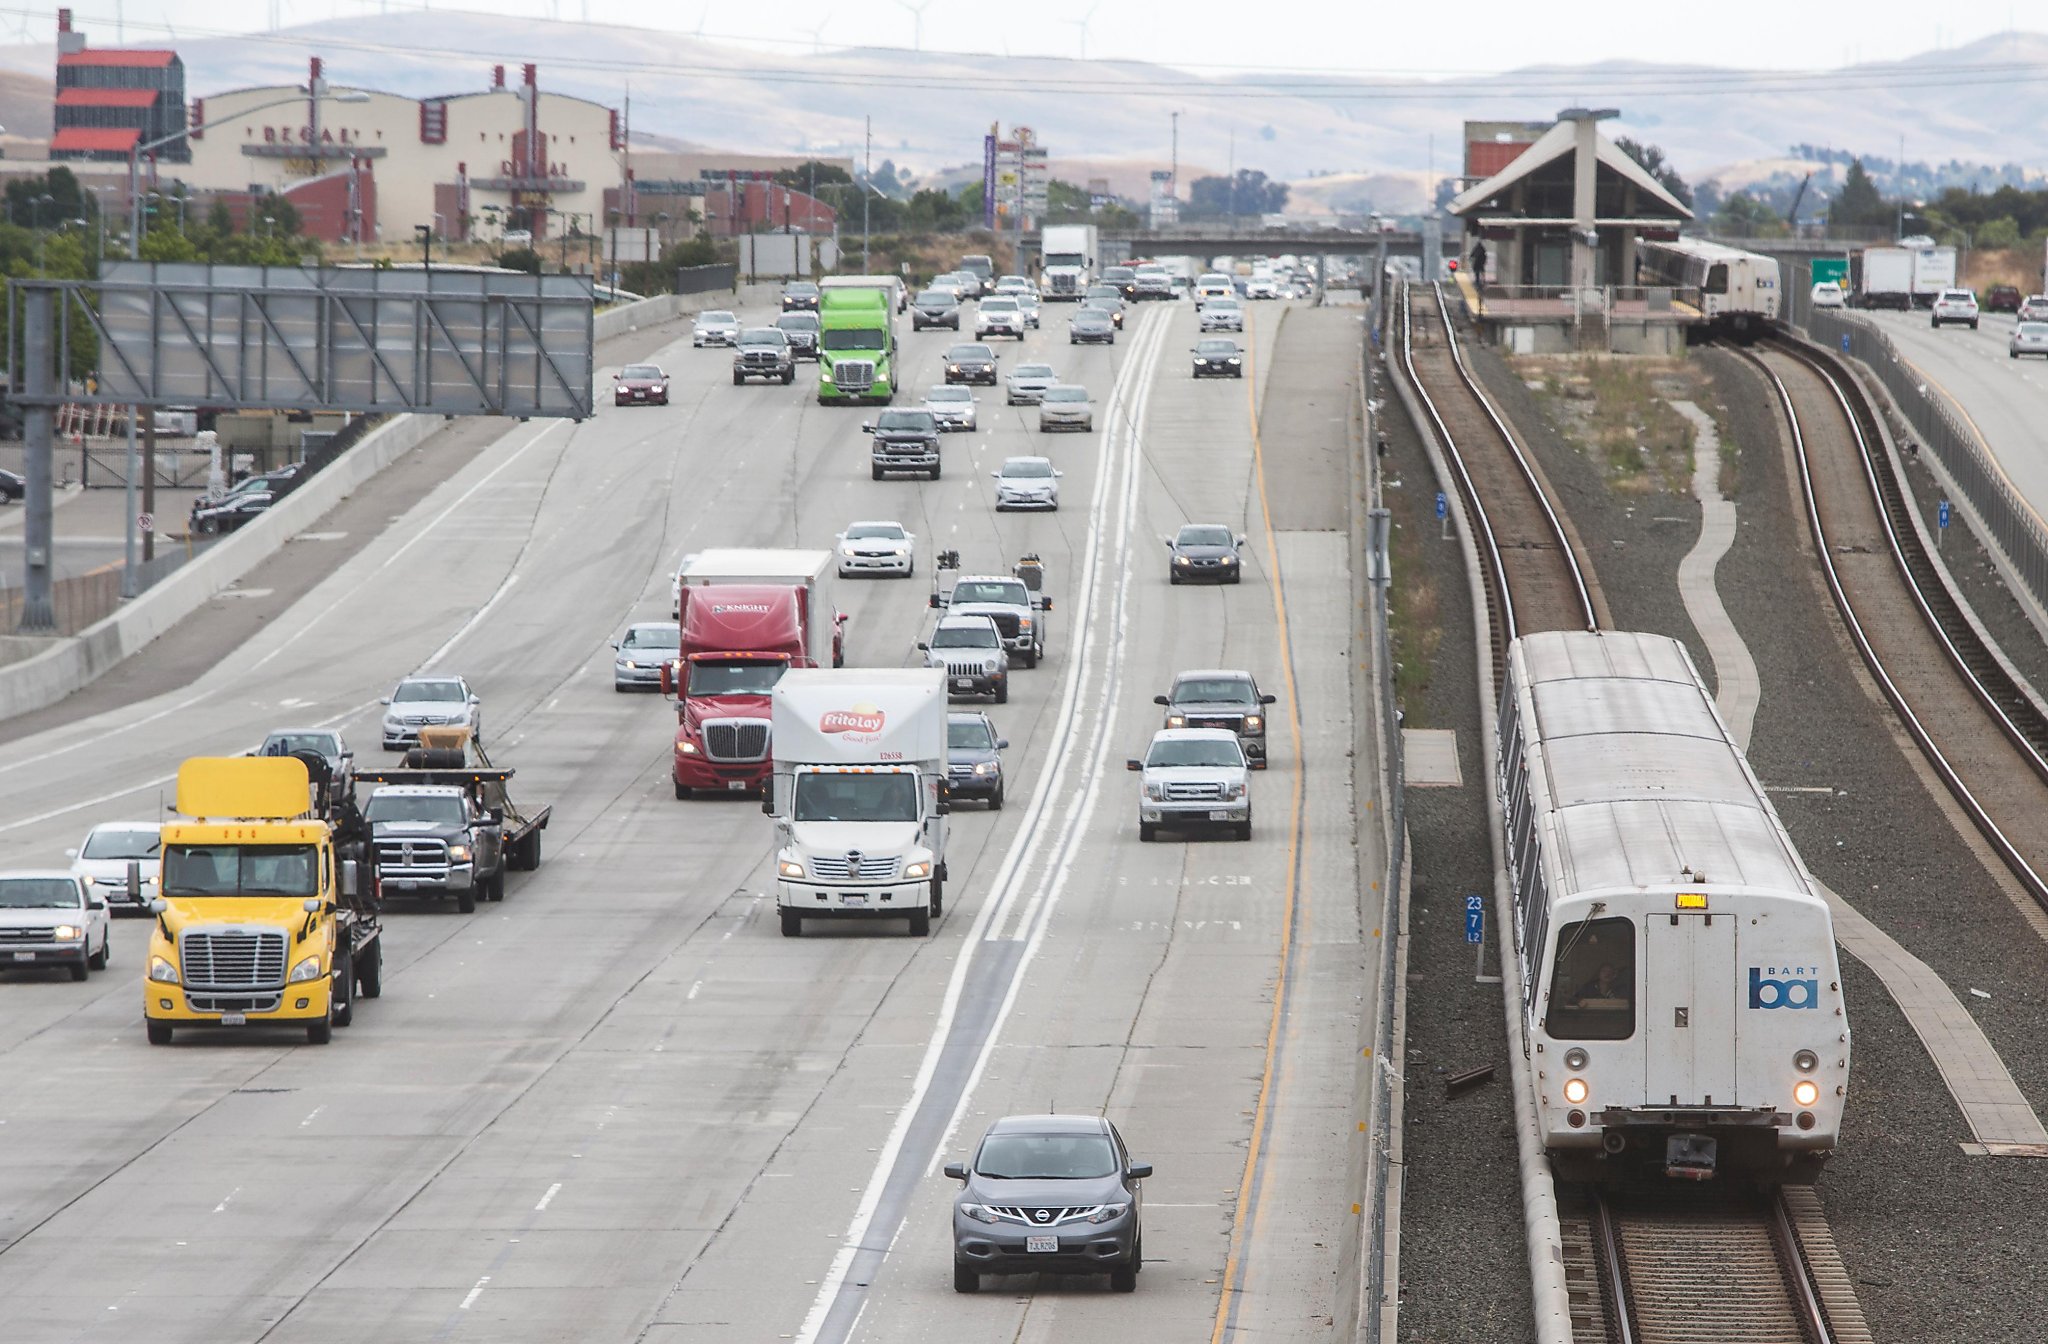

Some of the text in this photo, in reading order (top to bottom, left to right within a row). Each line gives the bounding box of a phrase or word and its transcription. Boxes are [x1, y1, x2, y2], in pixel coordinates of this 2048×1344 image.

[1467, 896, 1481, 910] 23
[1470, 914, 1478, 928] 7
[1468, 932, 1480, 942] L2
[1768, 967, 1818, 975] BART
